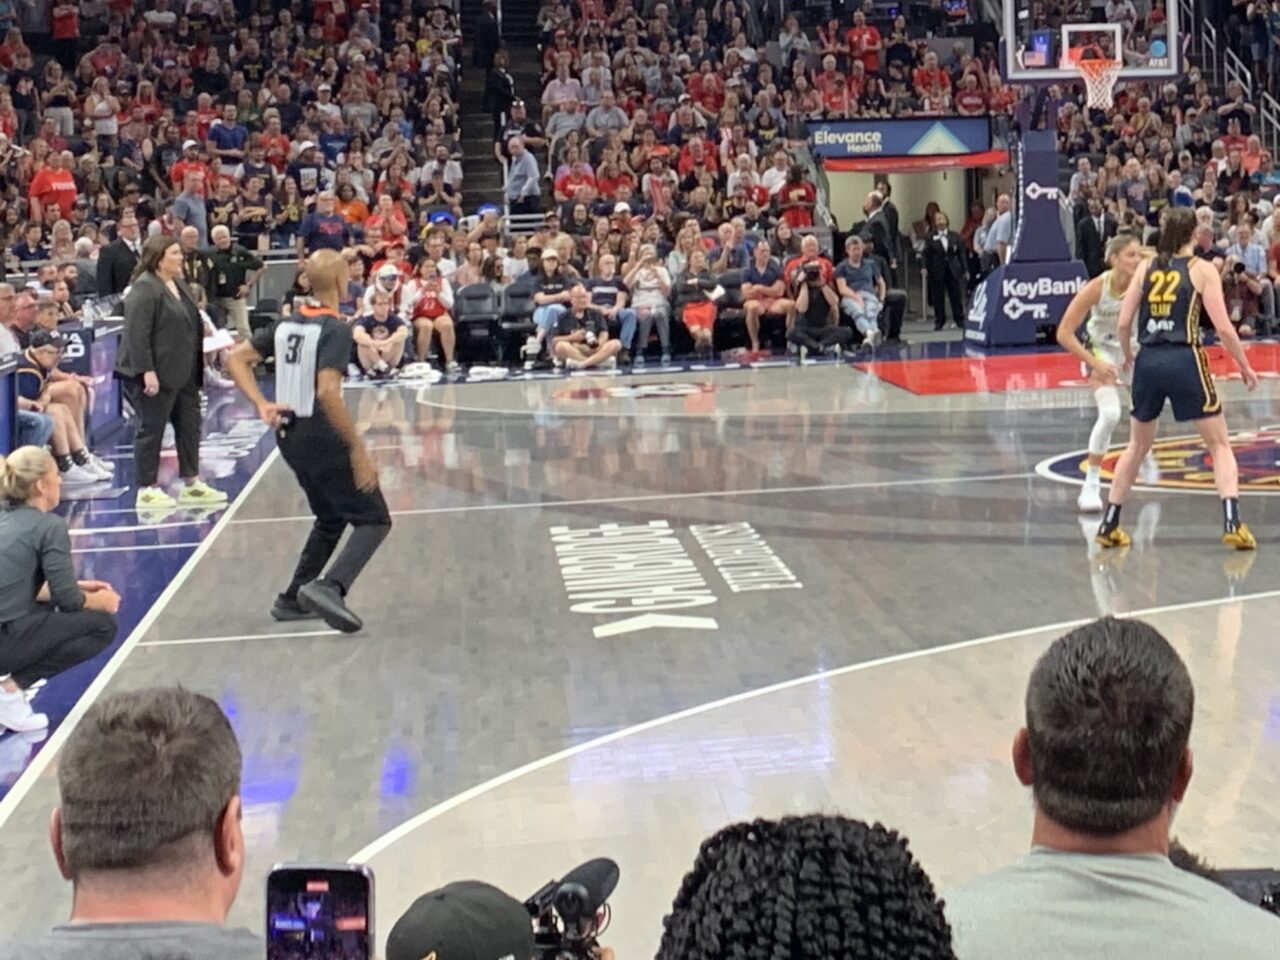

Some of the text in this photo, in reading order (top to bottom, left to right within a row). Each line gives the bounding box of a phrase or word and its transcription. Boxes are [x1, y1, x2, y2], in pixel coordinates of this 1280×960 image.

[814, 129, 882, 146] Elevance
[847, 142, 882, 153] Health
[1002, 276, 1087, 300] KeyBank
[1148, 270, 1181, 303] 22
